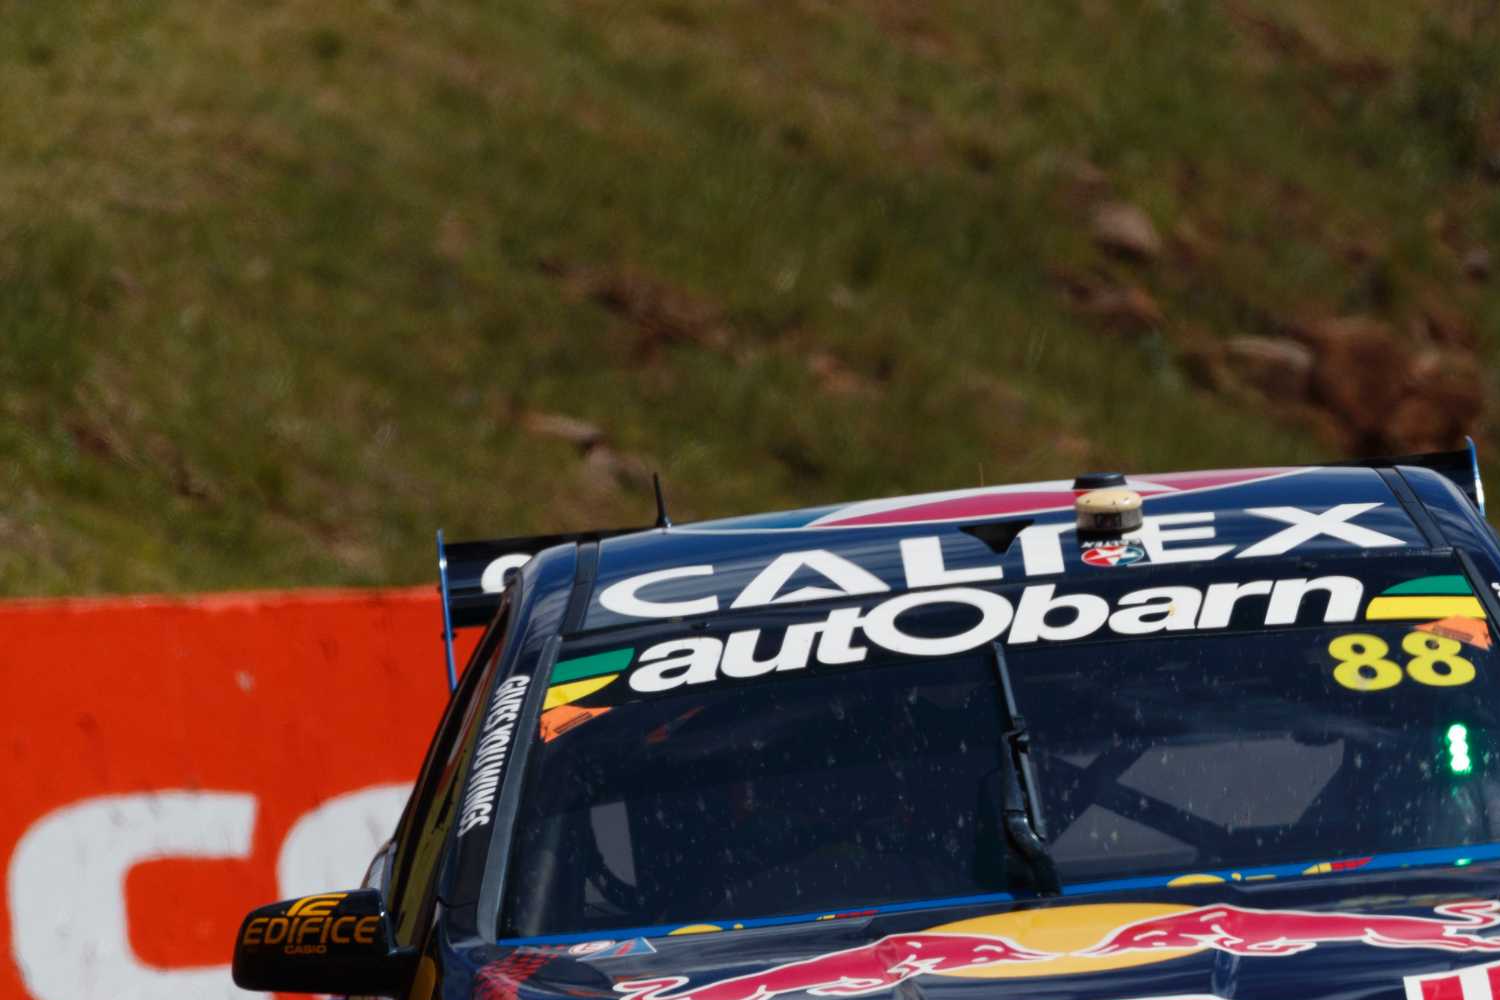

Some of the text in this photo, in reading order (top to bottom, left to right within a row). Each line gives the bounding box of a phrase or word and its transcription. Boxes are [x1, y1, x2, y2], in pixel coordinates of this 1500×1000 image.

[598, 502, 1407, 618] CALTEX
[1328, 631, 1476, 691] 88
[456, 674, 531, 838] GIVES YOU WINGS
[243, 915, 380, 944] EDIFICE
